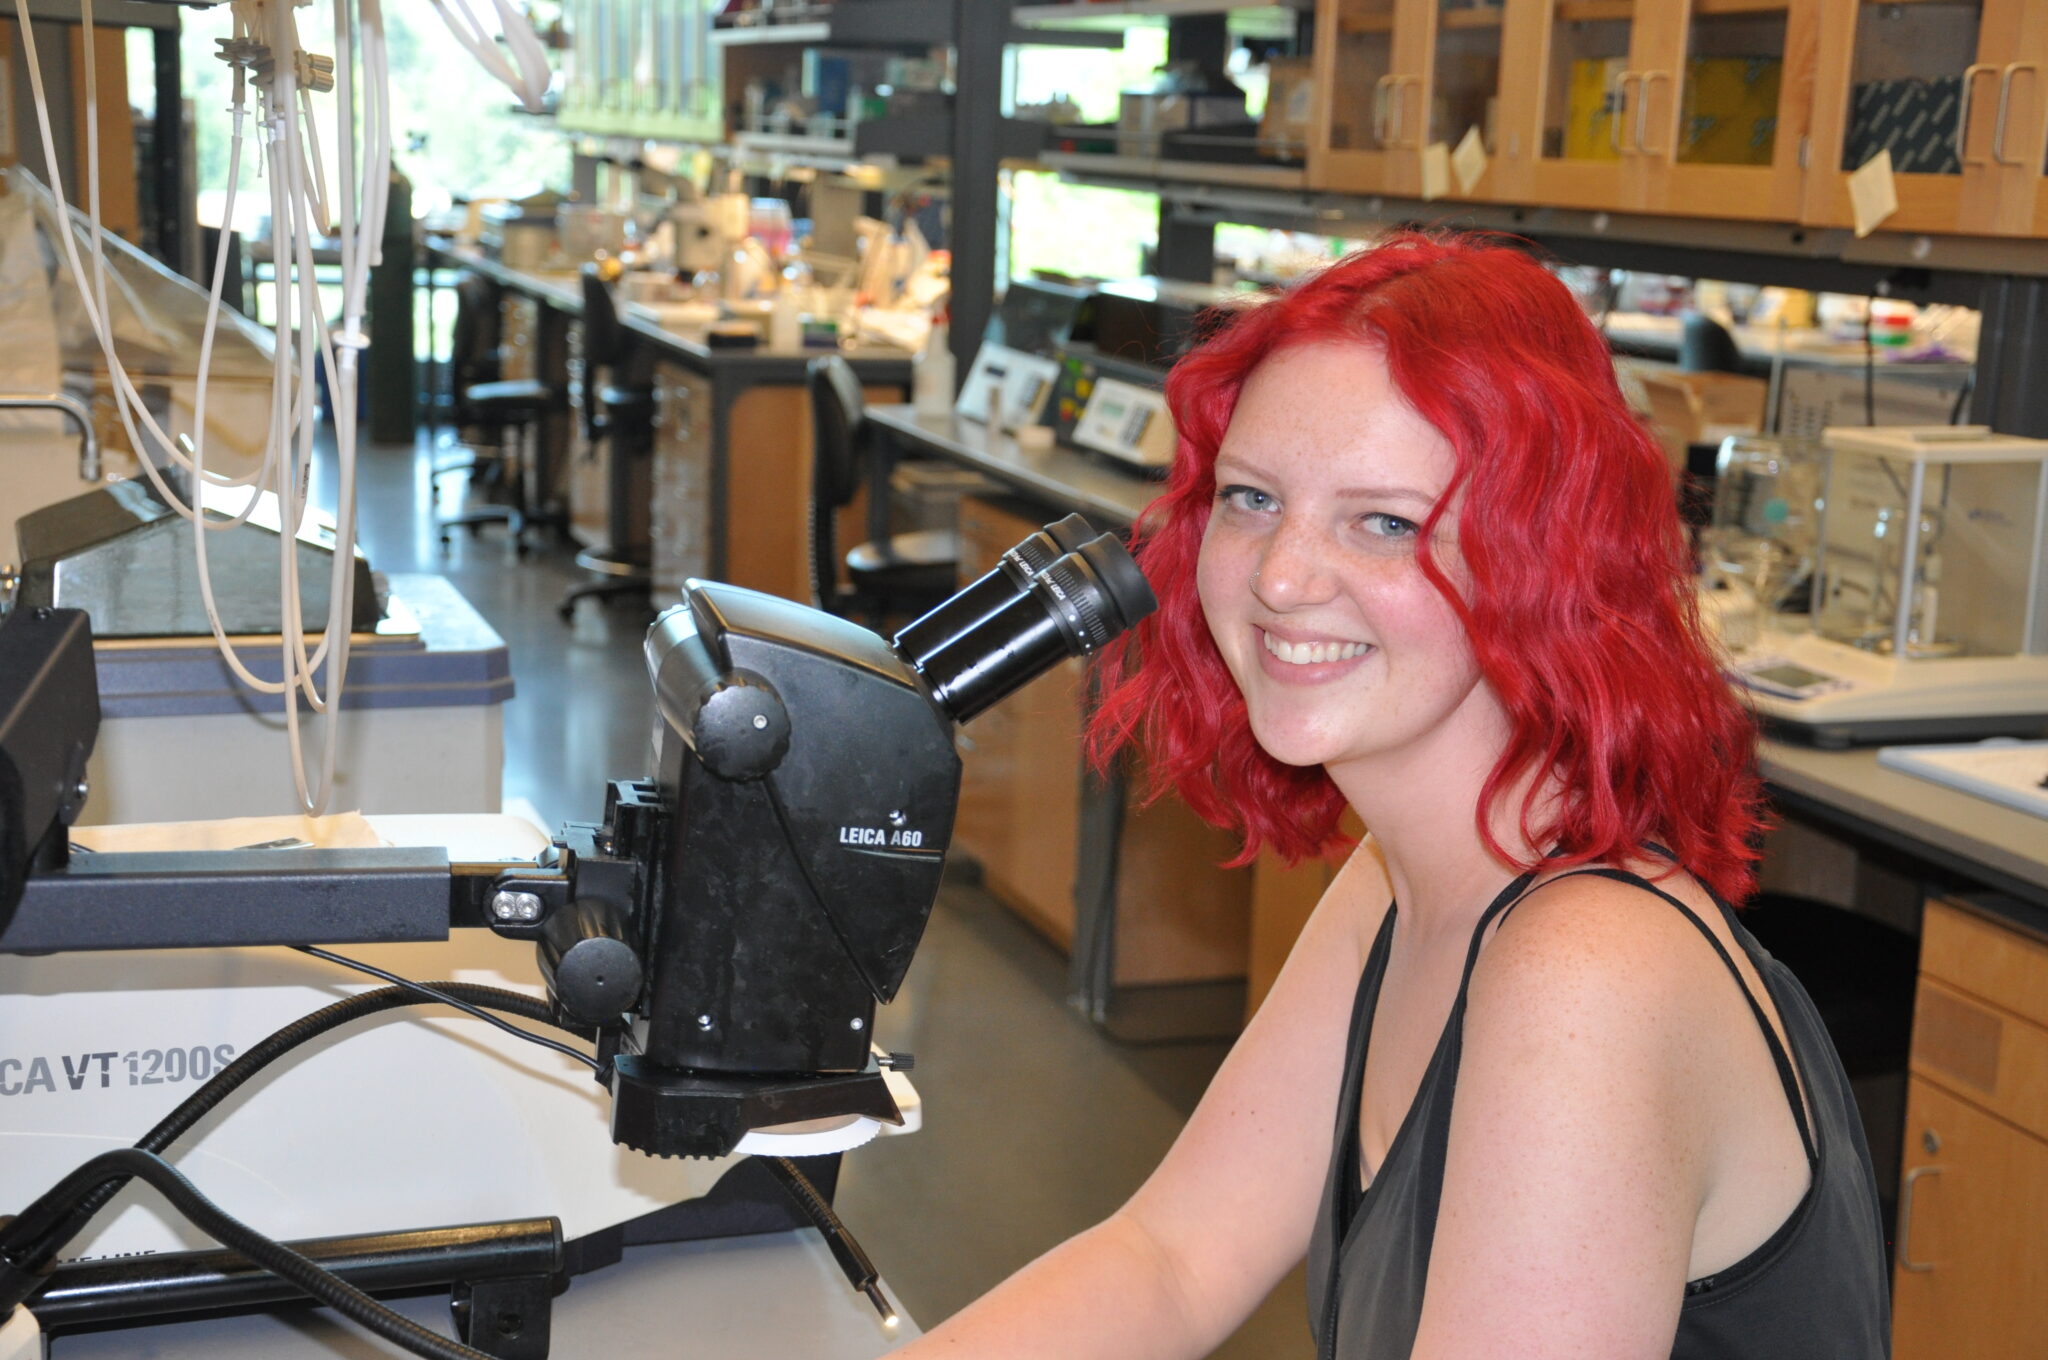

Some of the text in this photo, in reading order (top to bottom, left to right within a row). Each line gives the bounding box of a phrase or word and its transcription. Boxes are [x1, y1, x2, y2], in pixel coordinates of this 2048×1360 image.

[1019, 560, 1034, 577] LEICA
[1050, 583, 1066, 601] LEICA
[840, 827, 922, 847] LEICA A60
